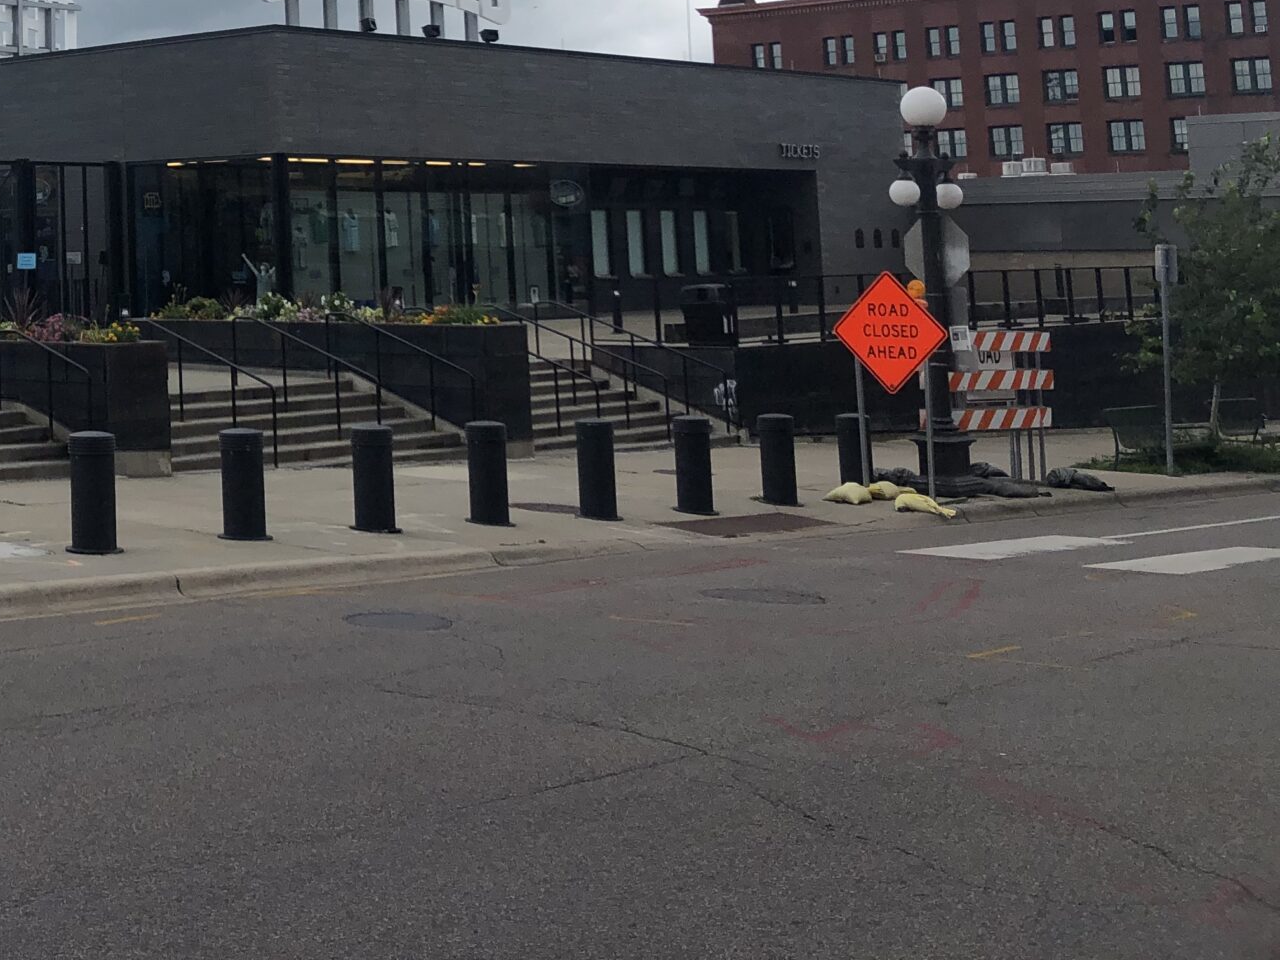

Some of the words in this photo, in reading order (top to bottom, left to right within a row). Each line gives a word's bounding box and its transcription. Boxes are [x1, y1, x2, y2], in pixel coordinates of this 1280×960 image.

[781, 143, 820, 159] TICKETS
[867, 303, 909, 317] ROAD
[863, 324, 919, 338] CLOSED
[867, 345, 917, 359] AHEAD
[978, 351, 1001, 364] OAD
